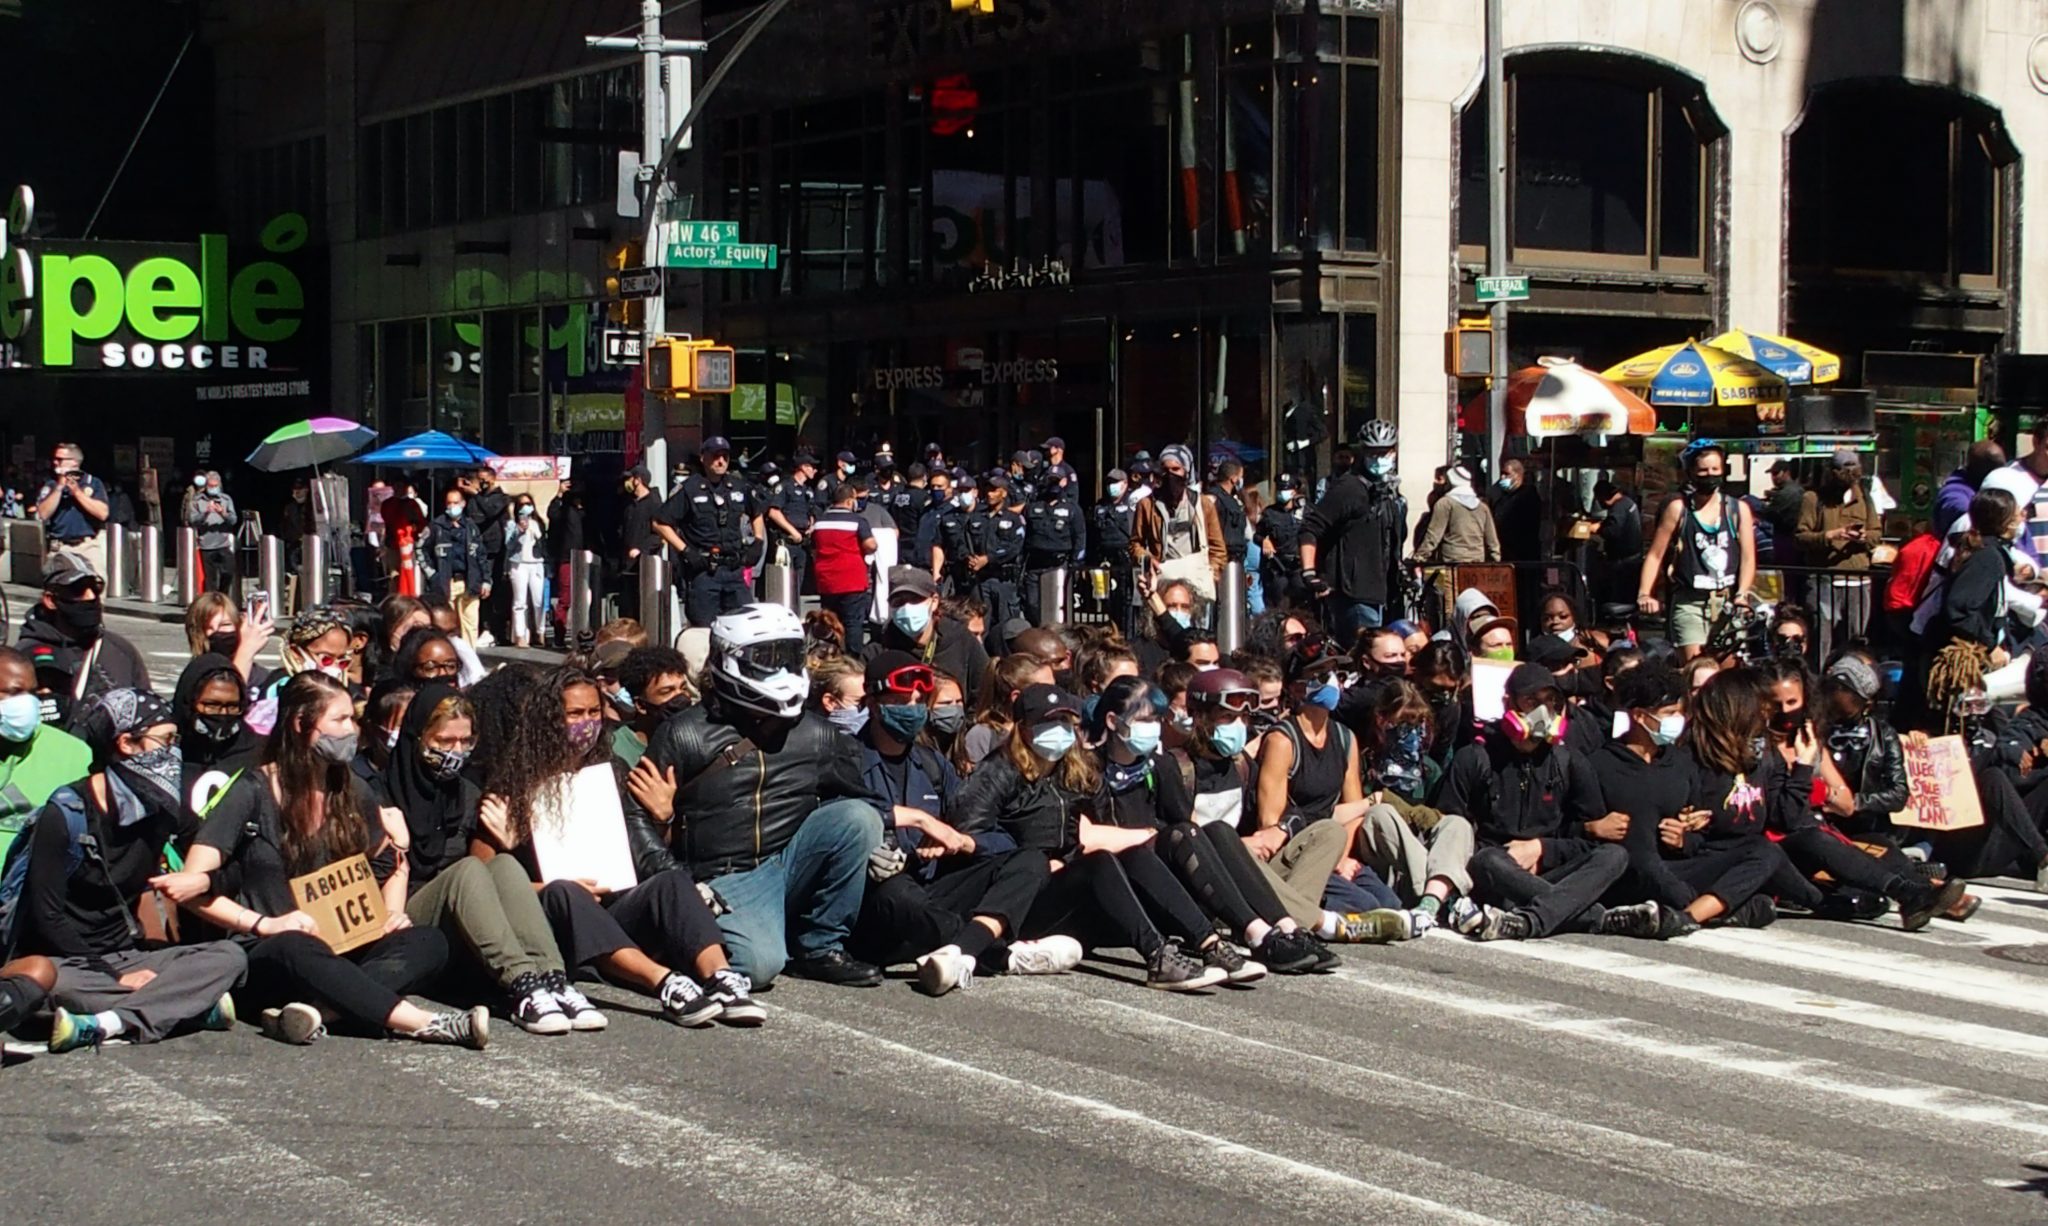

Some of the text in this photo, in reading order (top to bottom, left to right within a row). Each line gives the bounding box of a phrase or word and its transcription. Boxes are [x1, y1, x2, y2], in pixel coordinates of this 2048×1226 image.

[680, 225, 737, 243] W 46 St
[674, 245, 768, 263] Actors' Equity
[708, 258, 733, 266] Corner
[41, 212, 309, 366] pelé
[623, 279, 637, 291] ONE
[1480, 279, 1525, 293] LITTLE BRAZIL
[102, 343, 269, 368] SOCCER
[874, 366, 944, 389] EXPRESS
[980, 356, 1058, 384] EXPRESS
[263, 381, 287, 398] SOCCER
[289, 380, 309, 396] STORE
[1721, 384, 1782, 400] SABRETT
[304, 860, 372, 904] ABOLISH
[335, 892, 376, 935] ICE
